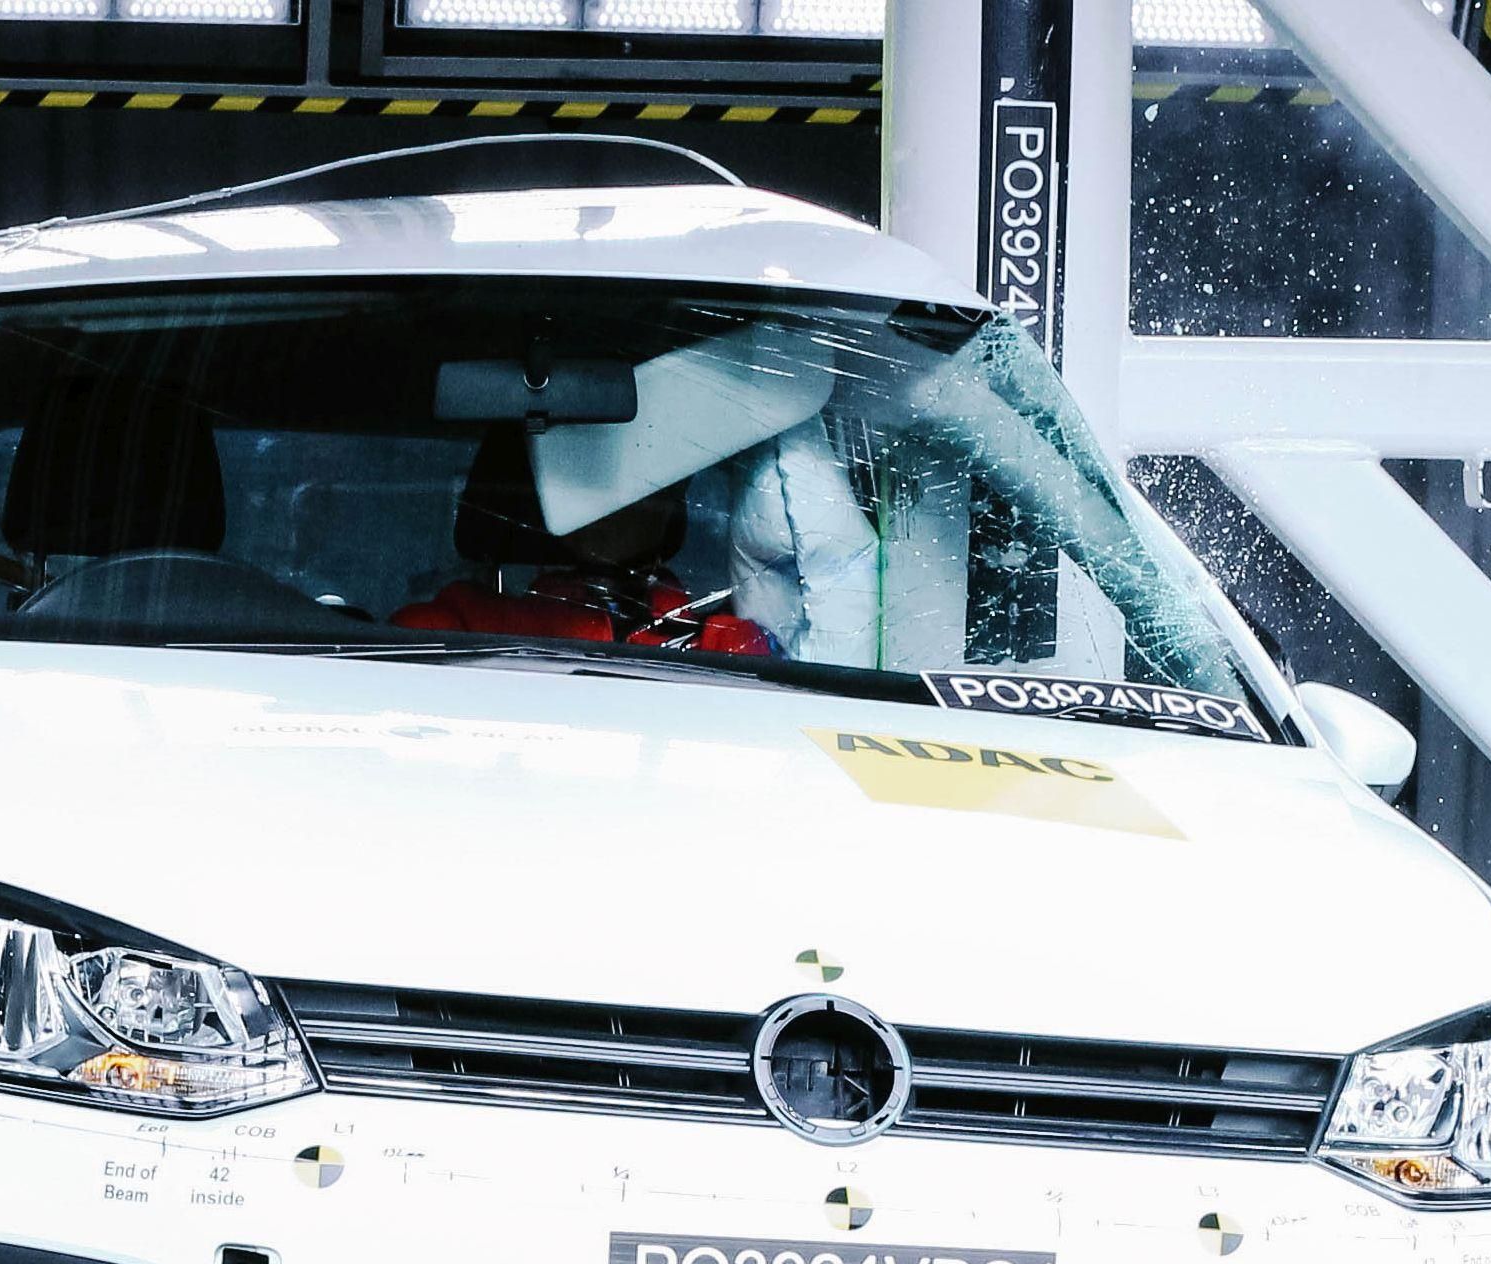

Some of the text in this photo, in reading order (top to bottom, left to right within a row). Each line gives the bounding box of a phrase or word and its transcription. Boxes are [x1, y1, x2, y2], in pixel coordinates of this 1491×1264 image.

[836, 733, 1114, 782] ADAC
[233, 1124, 278, 1140] COB
[334, 1122, 356, 1136] L1
[103, 1160, 159, 1181] End of
[208, 1166, 231, 1183] 42
[103, 1184, 150, 1204] Beam
[190, 1188, 246, 1207] inside
